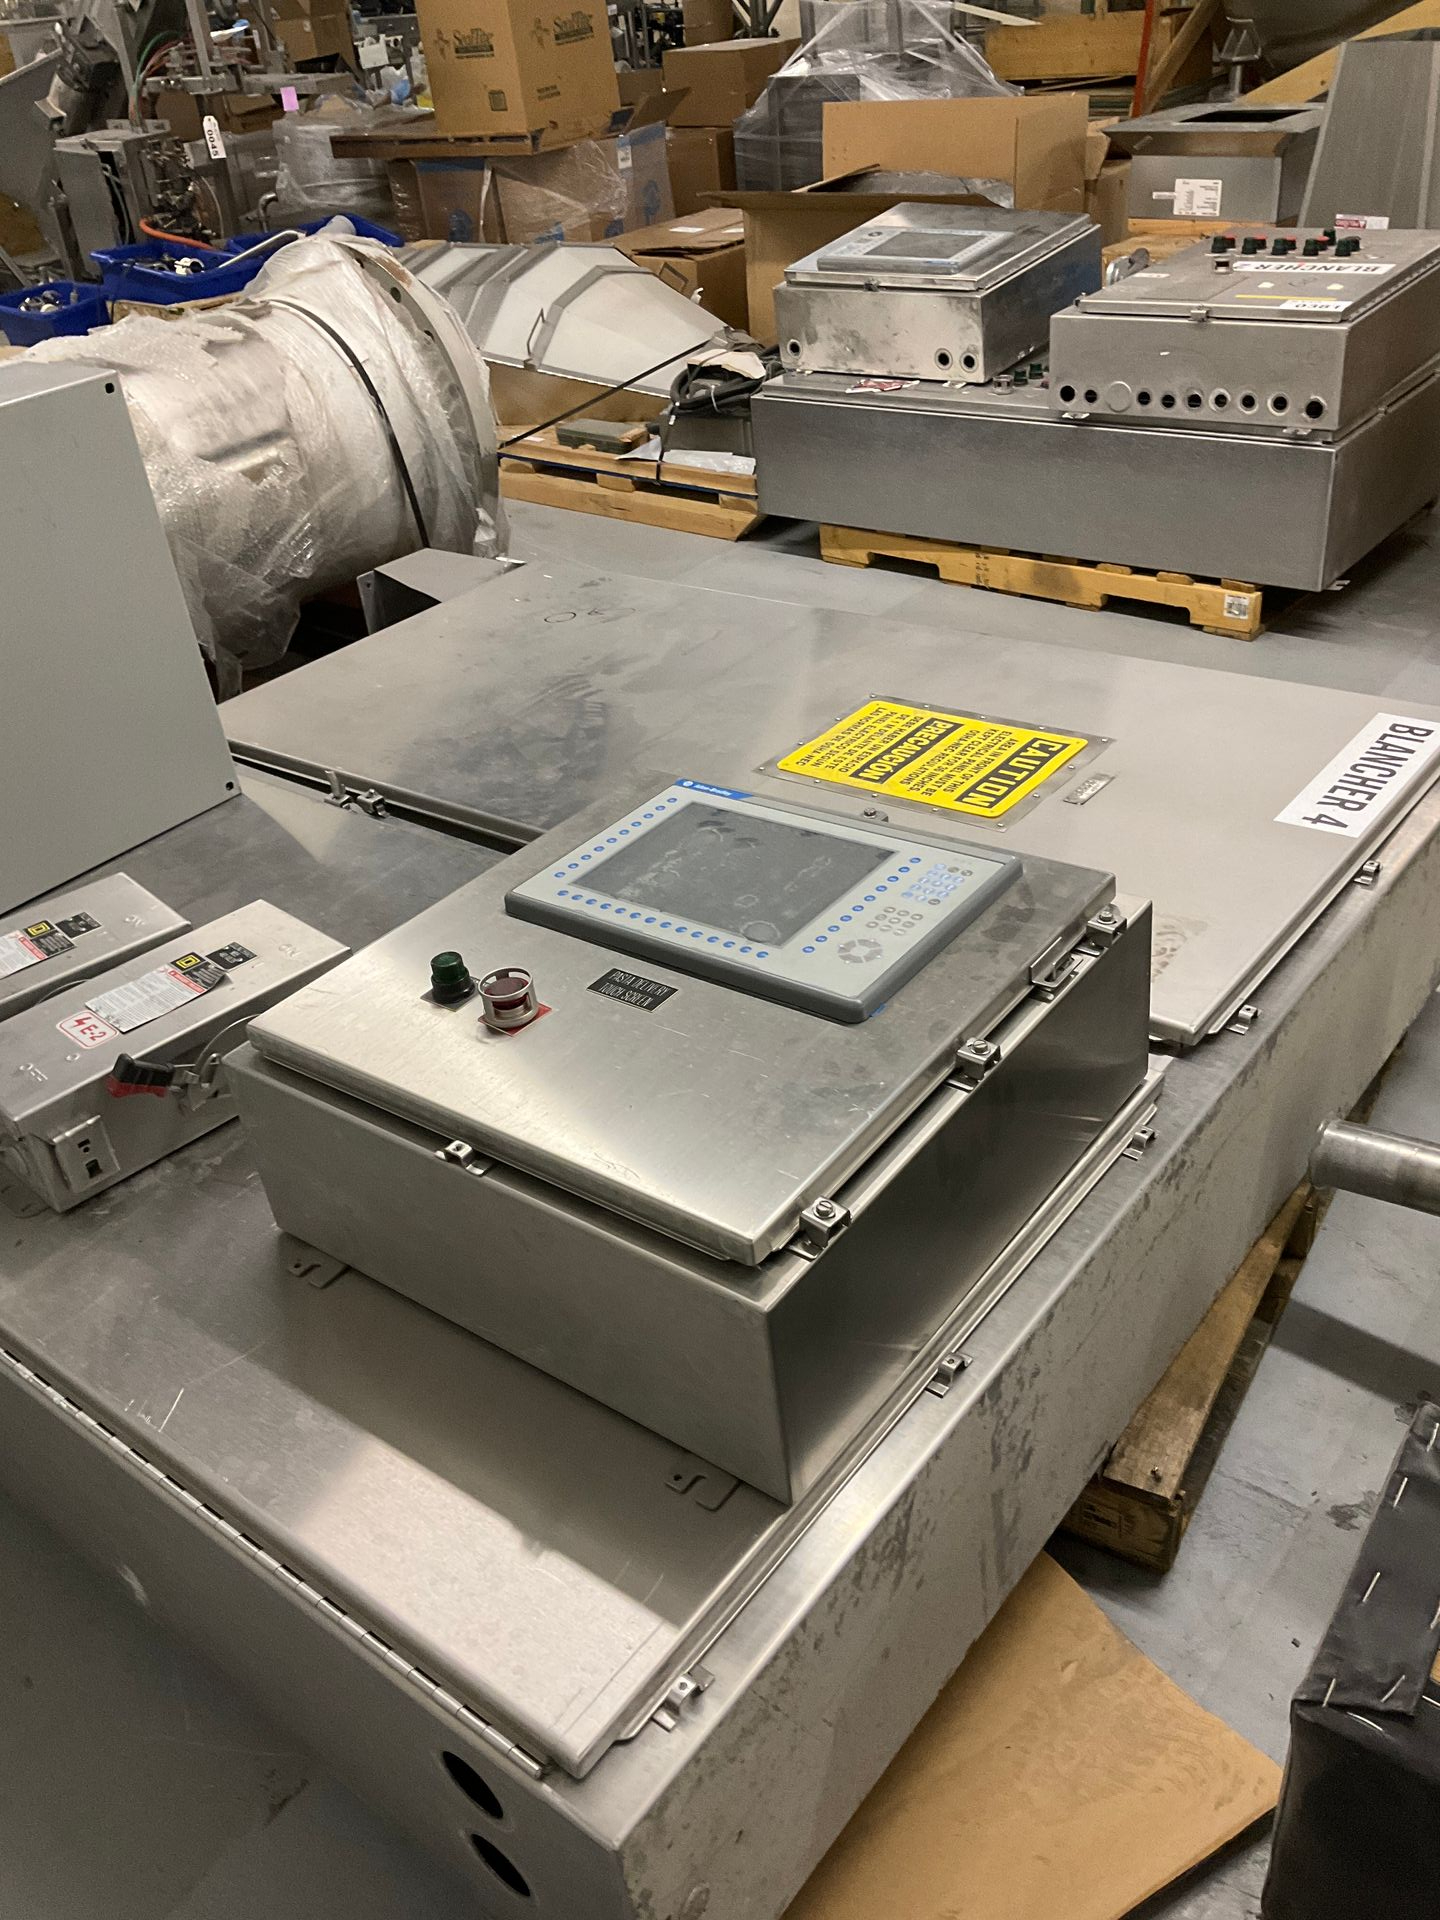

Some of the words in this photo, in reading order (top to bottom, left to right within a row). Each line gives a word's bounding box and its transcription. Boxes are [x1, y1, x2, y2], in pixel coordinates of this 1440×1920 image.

[207, 129, 219, 156] 0045
[1254, 263, 1379, 273] BLANCHER
[895, 713, 911, 721] DE
[977, 728, 1000, 741] KEPT
[858, 720, 954, 780] PRECAUCIÓN
[955, 740, 983, 757] CLEAR
[969, 730, 1013, 758] ELECTRICAL
[997, 738, 1019, 751] AREA
[843, 748, 858, 757] DE
[824, 755, 848, 770] ESTE
[899, 752, 950, 785] REGULATIONS
[942, 756, 963, 767] FOR
[949, 758, 977, 774] PANEL
[968, 757, 995, 774] FRONT
[1316, 723, 1434, 812] BLANCHER
[931, 773, 956, 789] MUST
[960, 773, 974, 781] OF
[962, 739, 1063, 807] CAUTION
[920, 787, 937, 797] BE
[942, 780, 965, 793] THIS
[1302, 813, 1349, 829] 4
[608, 970, 636, 985] PASTA
[630, 978, 669, 997] DELIVERY
[597, 982, 626, 997] TOUCH
[621, 990, 654, 1007] SCREEN
[79, 1024, 107, 1042] E-2
